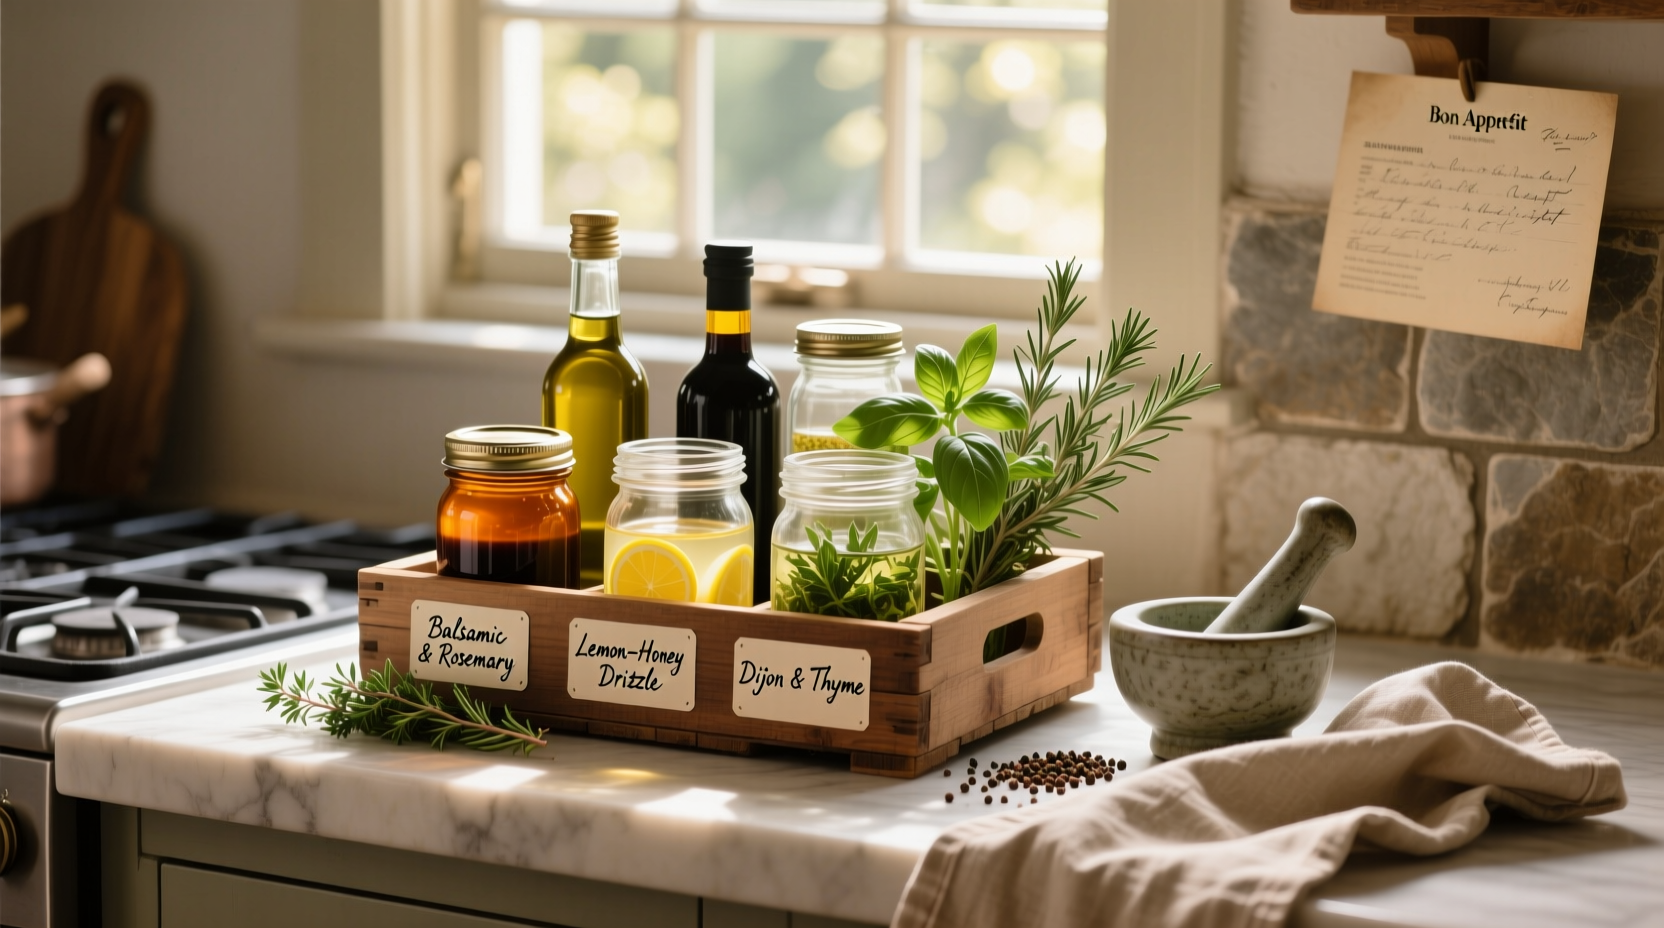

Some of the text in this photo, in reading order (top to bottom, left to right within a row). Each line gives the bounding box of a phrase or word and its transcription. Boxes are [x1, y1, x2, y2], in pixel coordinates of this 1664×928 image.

[1430, 105, 1459, 126] Bon
[428, 615, 507, 644] Balsamic
[418, 643, 514, 681] & Rosemary
[575, 632, 684, 676] Lemon-Honey
[739, 660, 865, 704] Dijon & Thyme
